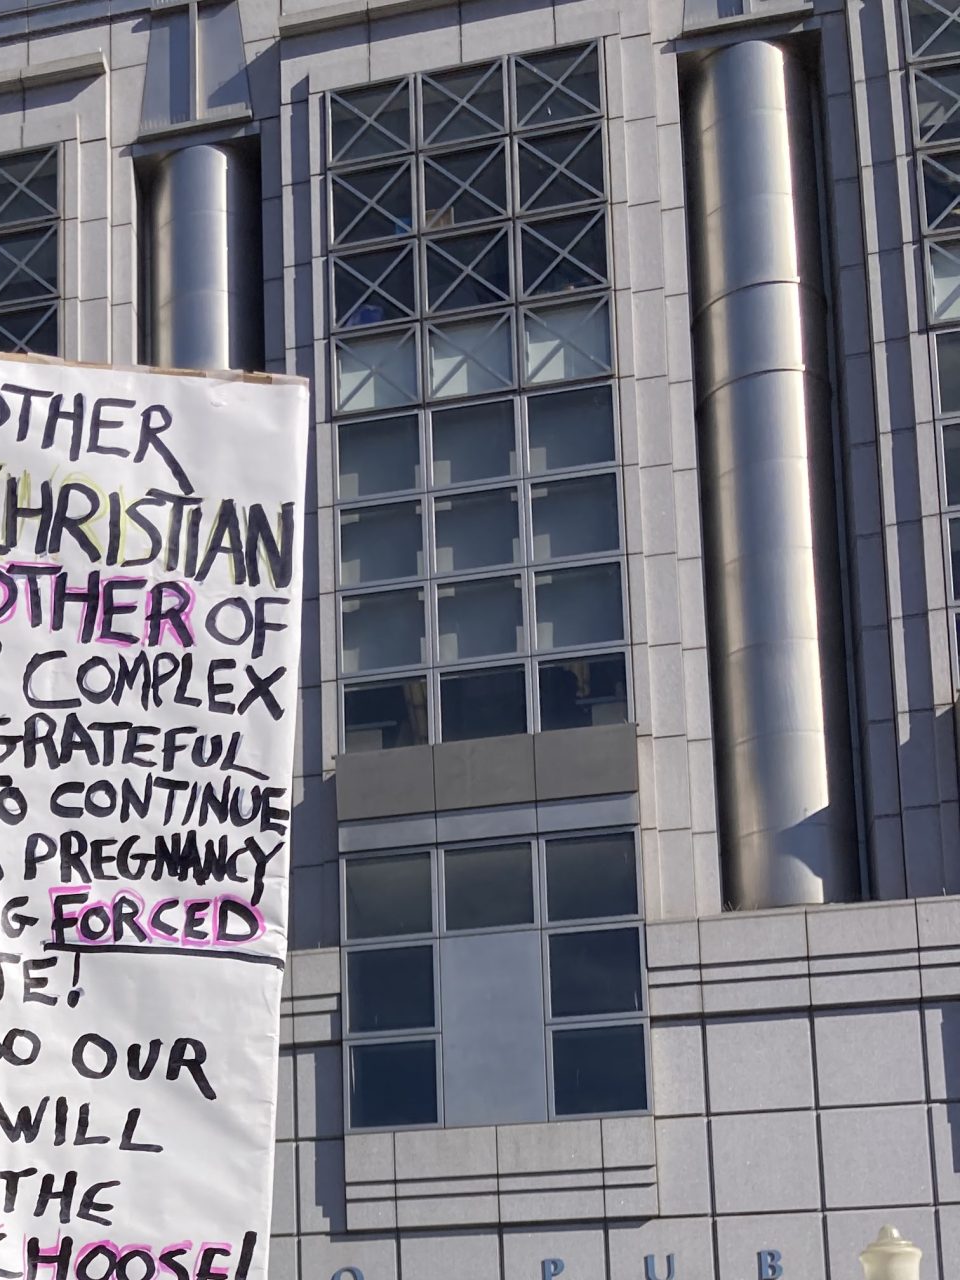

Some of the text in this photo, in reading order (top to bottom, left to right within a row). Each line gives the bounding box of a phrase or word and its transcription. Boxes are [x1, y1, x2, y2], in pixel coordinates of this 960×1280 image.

[206, 597, 289, 659] OF
[23, 651, 286, 720] COMPLEX
[51, 776, 289, 835] CONTINUE
[24, 830, 285, 905] PREGNANCY
[52, 894, 258, 945] FORCED
[72, 1034, 216, 1100] OUR
[0, 1168, 120, 1225] THE
